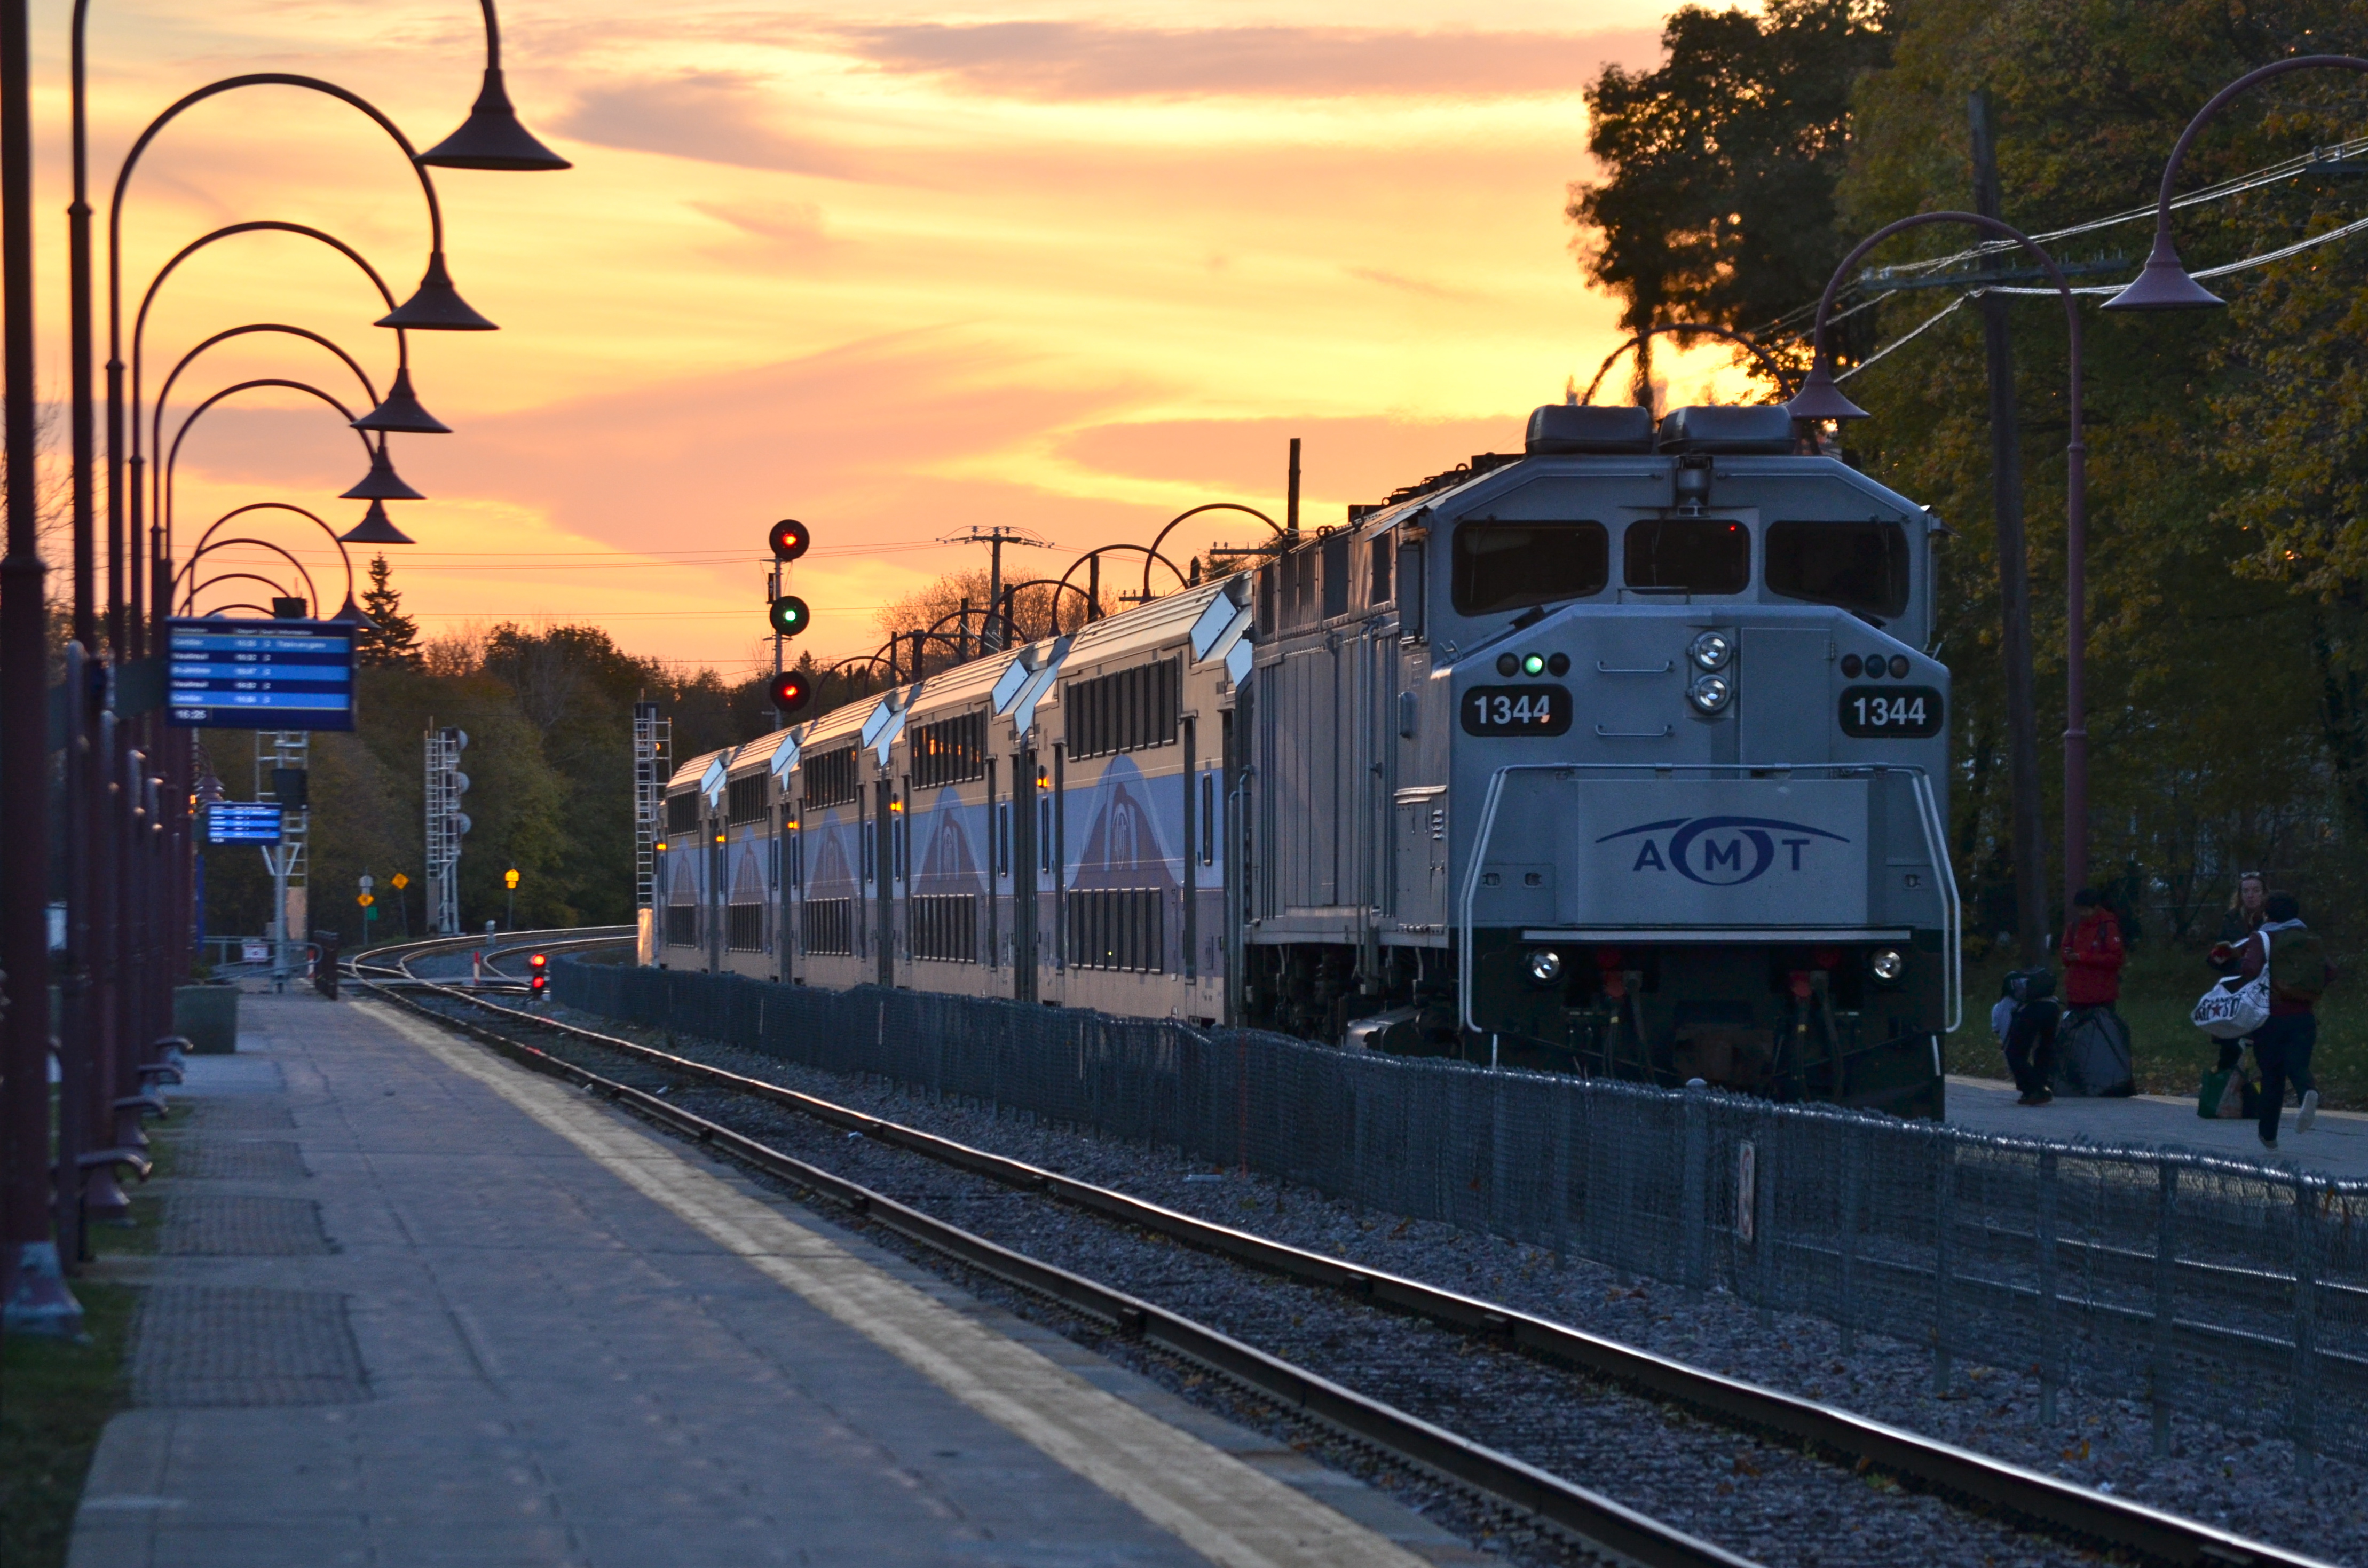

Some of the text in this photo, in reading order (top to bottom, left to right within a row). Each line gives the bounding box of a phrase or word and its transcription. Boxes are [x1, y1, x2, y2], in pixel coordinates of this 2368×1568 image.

[175, 710, 207, 720] 16:25
[1474, 695, 1550, 724] 1344
[1853, 697, 1927, 725] 1344
[1632, 838, 1811, 872] AMT
